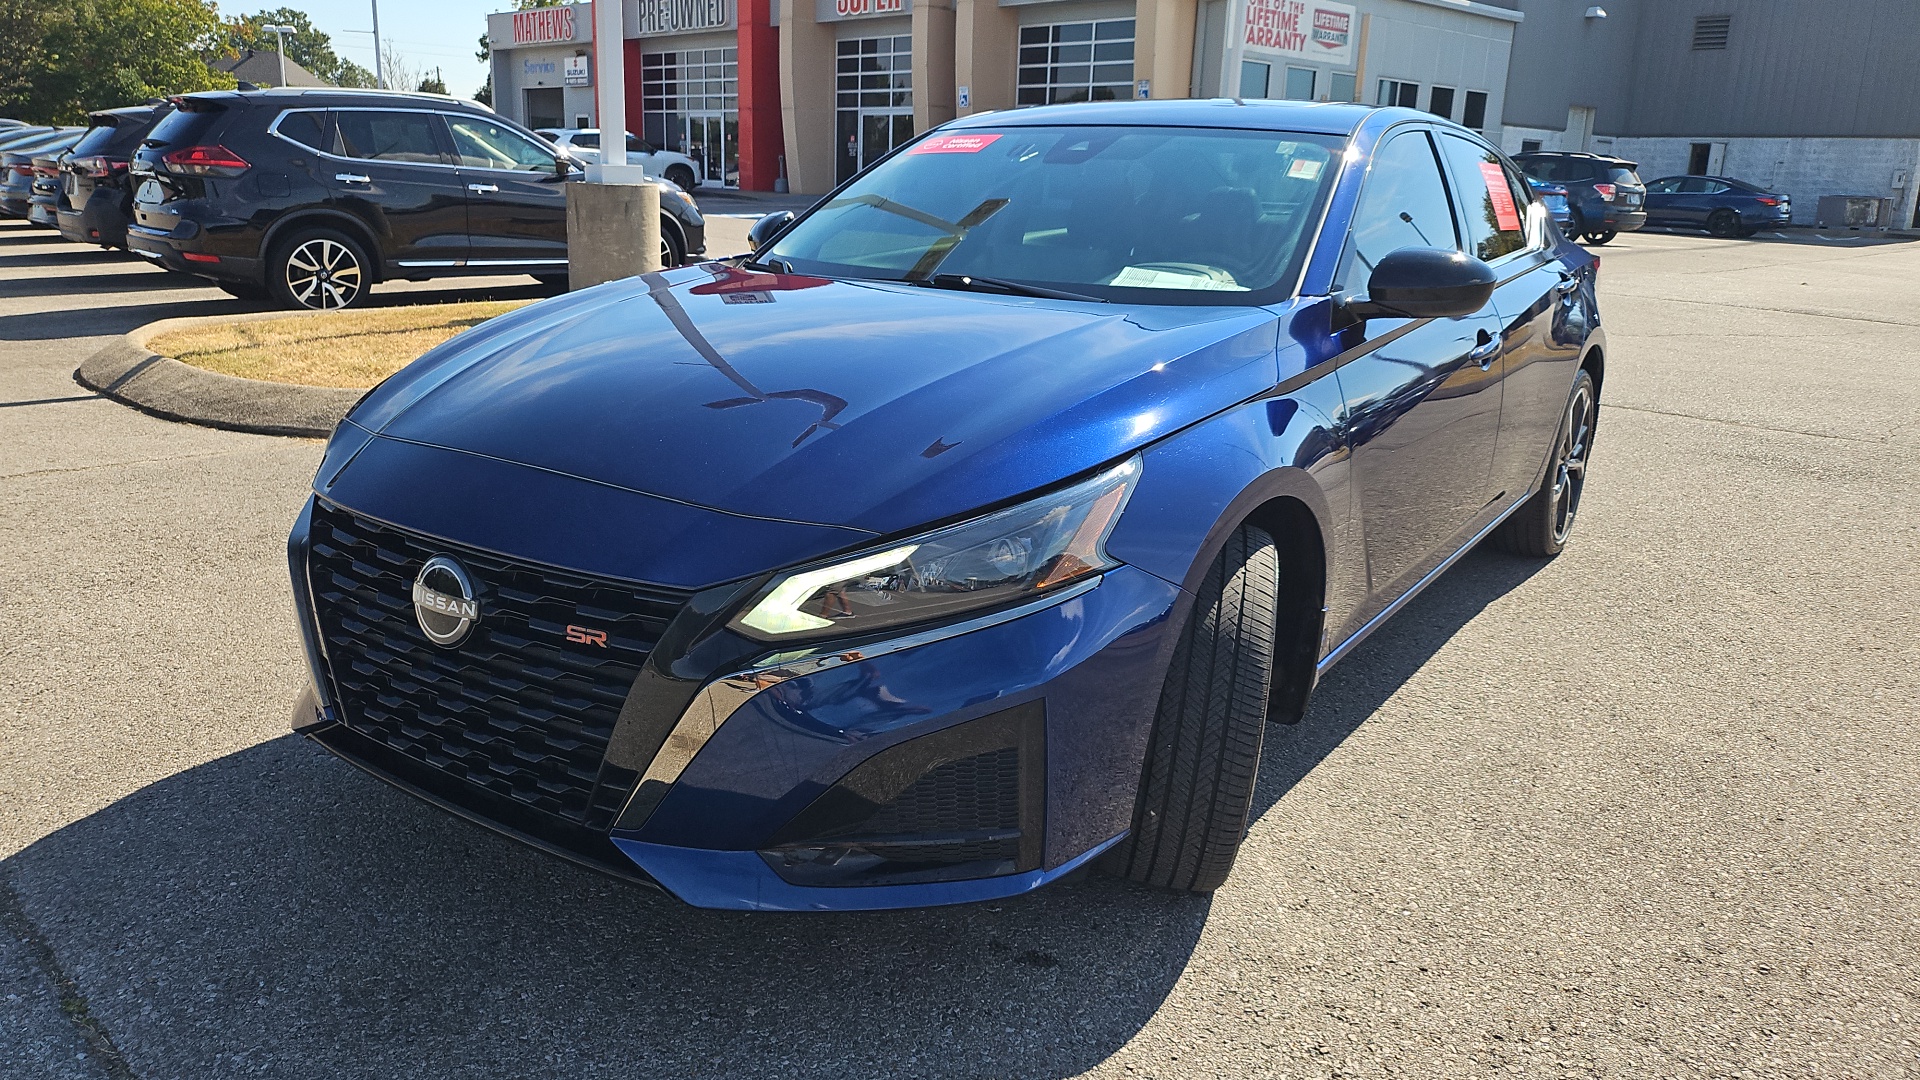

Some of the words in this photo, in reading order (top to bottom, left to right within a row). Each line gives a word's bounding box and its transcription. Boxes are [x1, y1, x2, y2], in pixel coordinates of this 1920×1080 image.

[638, 0, 727, 34] PRE-OWNED
[1246, 5, 1299, 32] LIFETIME
[1289, 1, 1305, 14] THE
[512, 7, 573, 44] MATHEWS
[1314, 11, 1349, 31] LIFETIME
[1244, 25, 1307, 51] ARRANTY
[415, 587, 476, 617] NISSAN
[566, 624, 608, 648] SR
